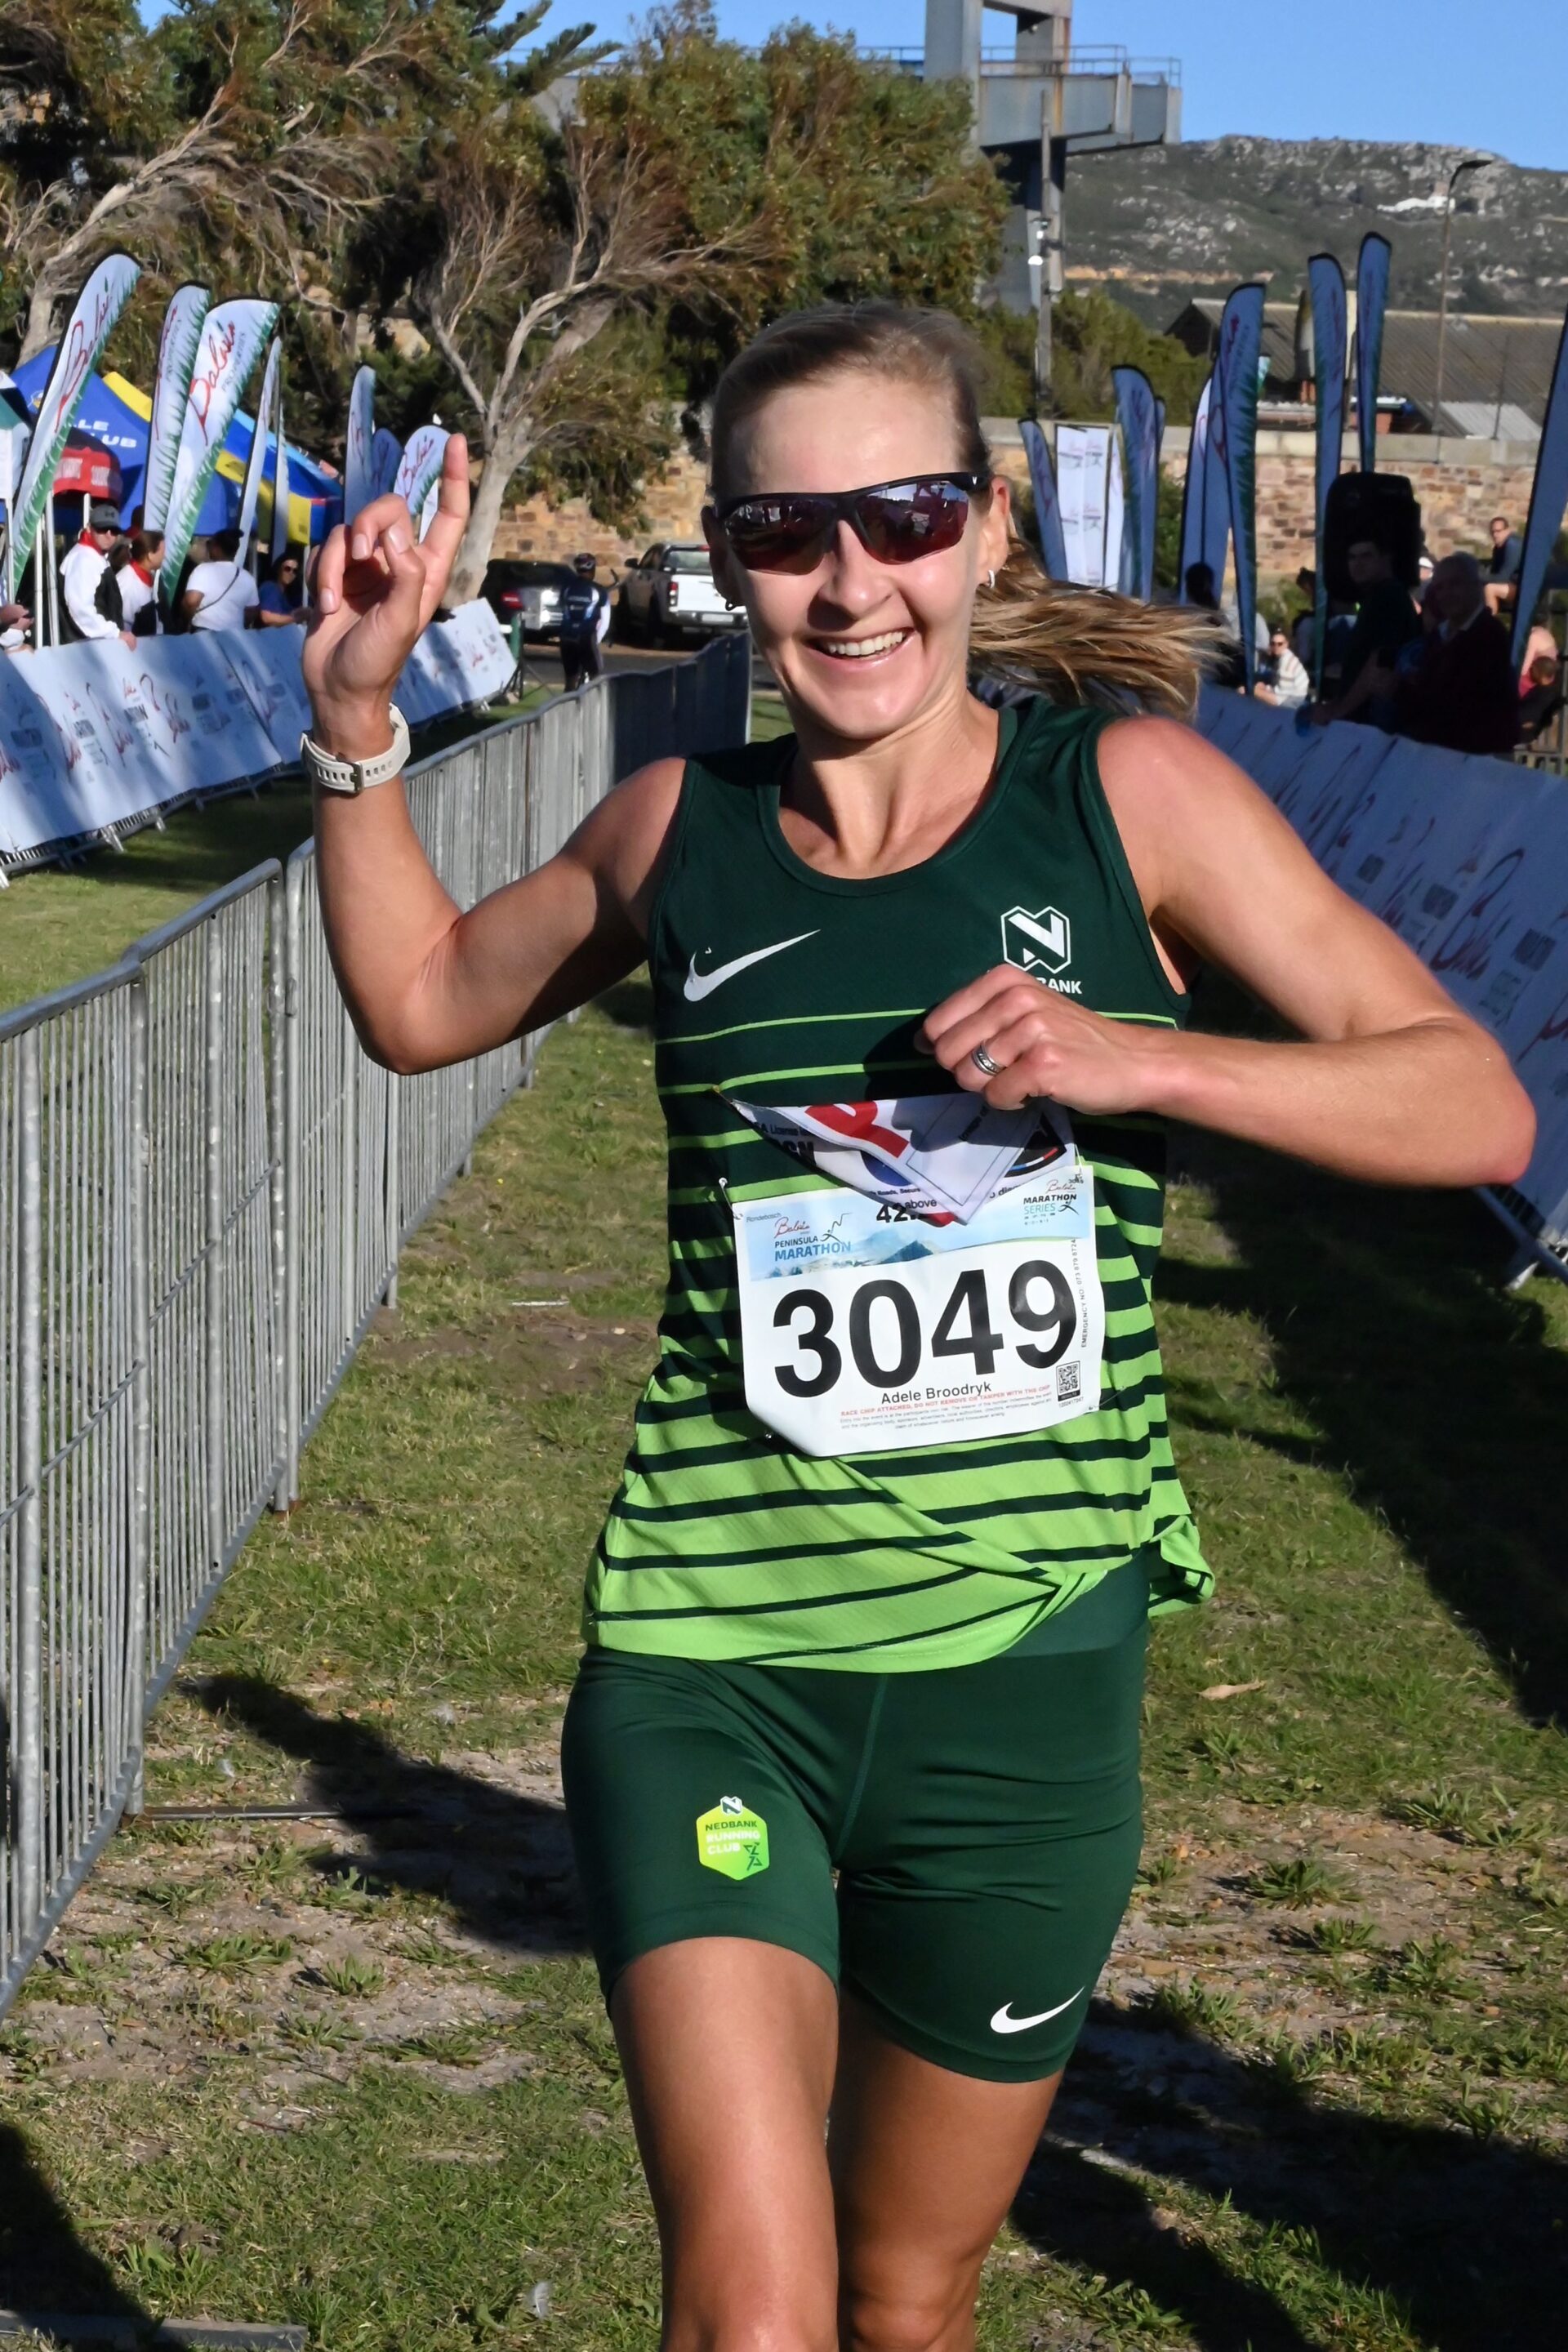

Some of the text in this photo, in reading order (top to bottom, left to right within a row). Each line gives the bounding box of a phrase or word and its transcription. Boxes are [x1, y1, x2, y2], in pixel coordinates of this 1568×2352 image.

[905, 1199, 938, 1209] above
[1023, 1193, 1077, 1205] MARATHON
[1023, 1202, 1056, 1215] SERIES
[774, 1236, 818, 1249] PENINSULA
[774, 1241, 852, 1263] MARATHON
[773, 1259, 1077, 1398] 3049
[1080, 1303, 1089, 1348] EMERGENCY
[881, 1381, 991, 1405] Adele Broodryk
[940, 1396, 967, 1405] REMOVE
[979, 1392, 1005, 1401] TAMPER
[705, 1820, 758, 1832] NEDBANK
[706, 1829, 761, 1843] RUNNING
[707, 1842, 741, 1856] CLUB
